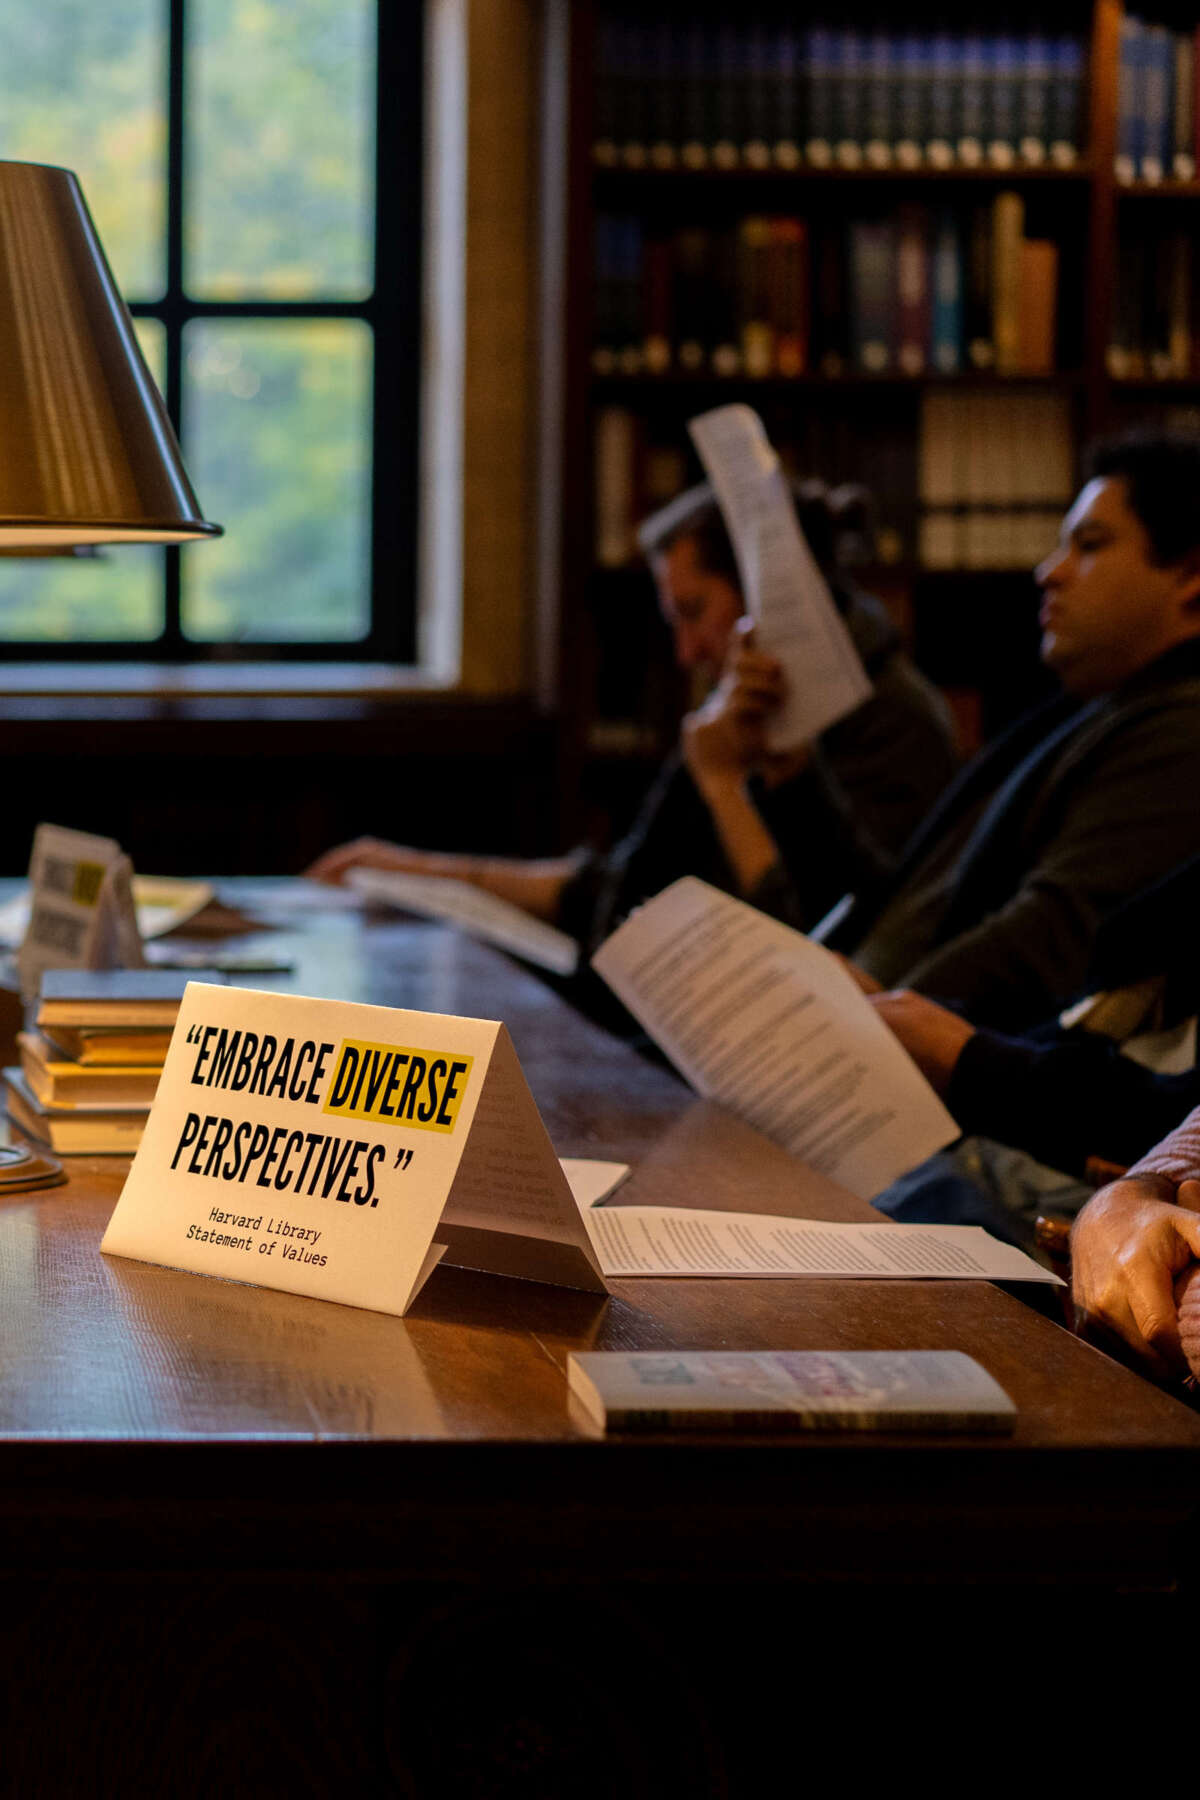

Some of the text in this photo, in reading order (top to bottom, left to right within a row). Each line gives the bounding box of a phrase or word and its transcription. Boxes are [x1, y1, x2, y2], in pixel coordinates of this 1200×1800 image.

[186, 1024, 467, 1125] “EMBRACE DIVERSE
[186, 1224, 328, 1267] Statement of Values
[209, 1207, 322, 1245] Harvard Library
